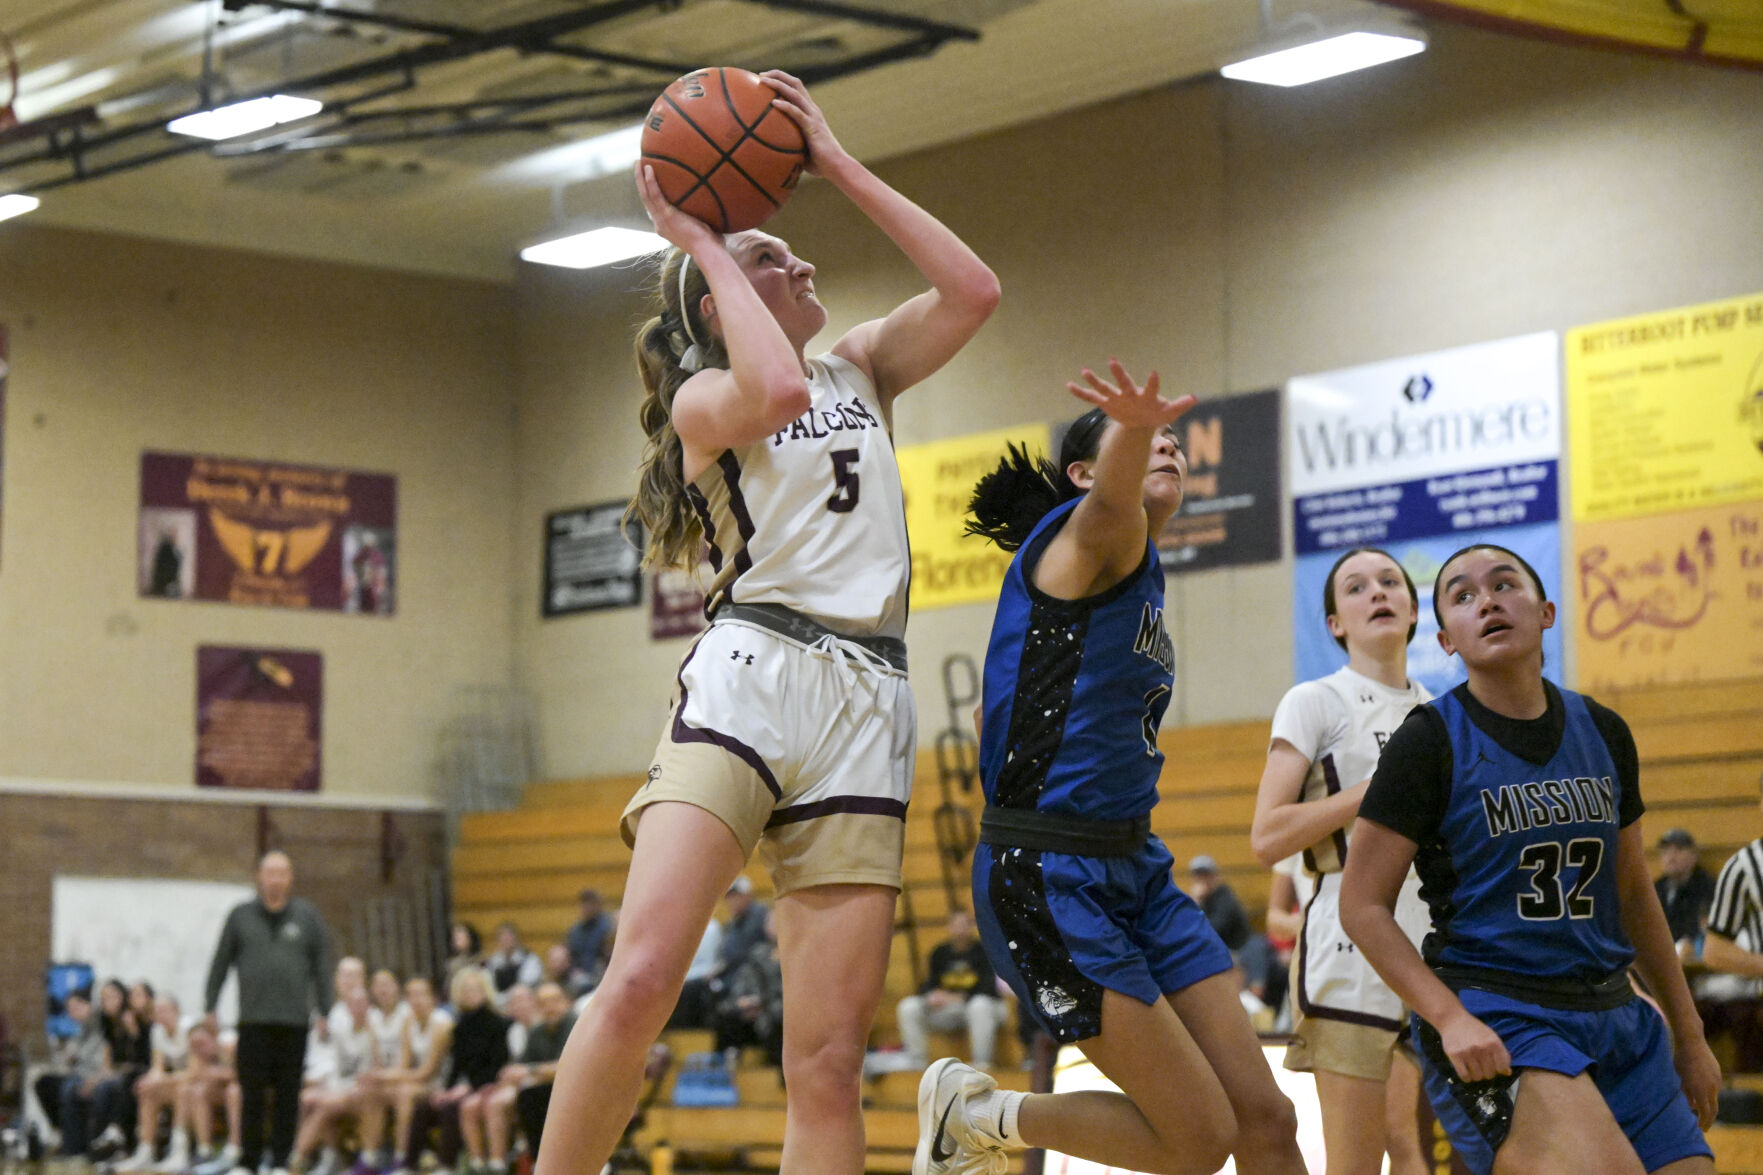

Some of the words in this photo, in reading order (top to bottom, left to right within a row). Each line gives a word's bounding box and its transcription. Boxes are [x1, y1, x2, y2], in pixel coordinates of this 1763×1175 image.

[1298, 399, 1550, 474] Windermere
[827, 448, 860, 513] 5
[1480, 775, 1617, 838] MISSION
[1516, 837, 1605, 921] 32
